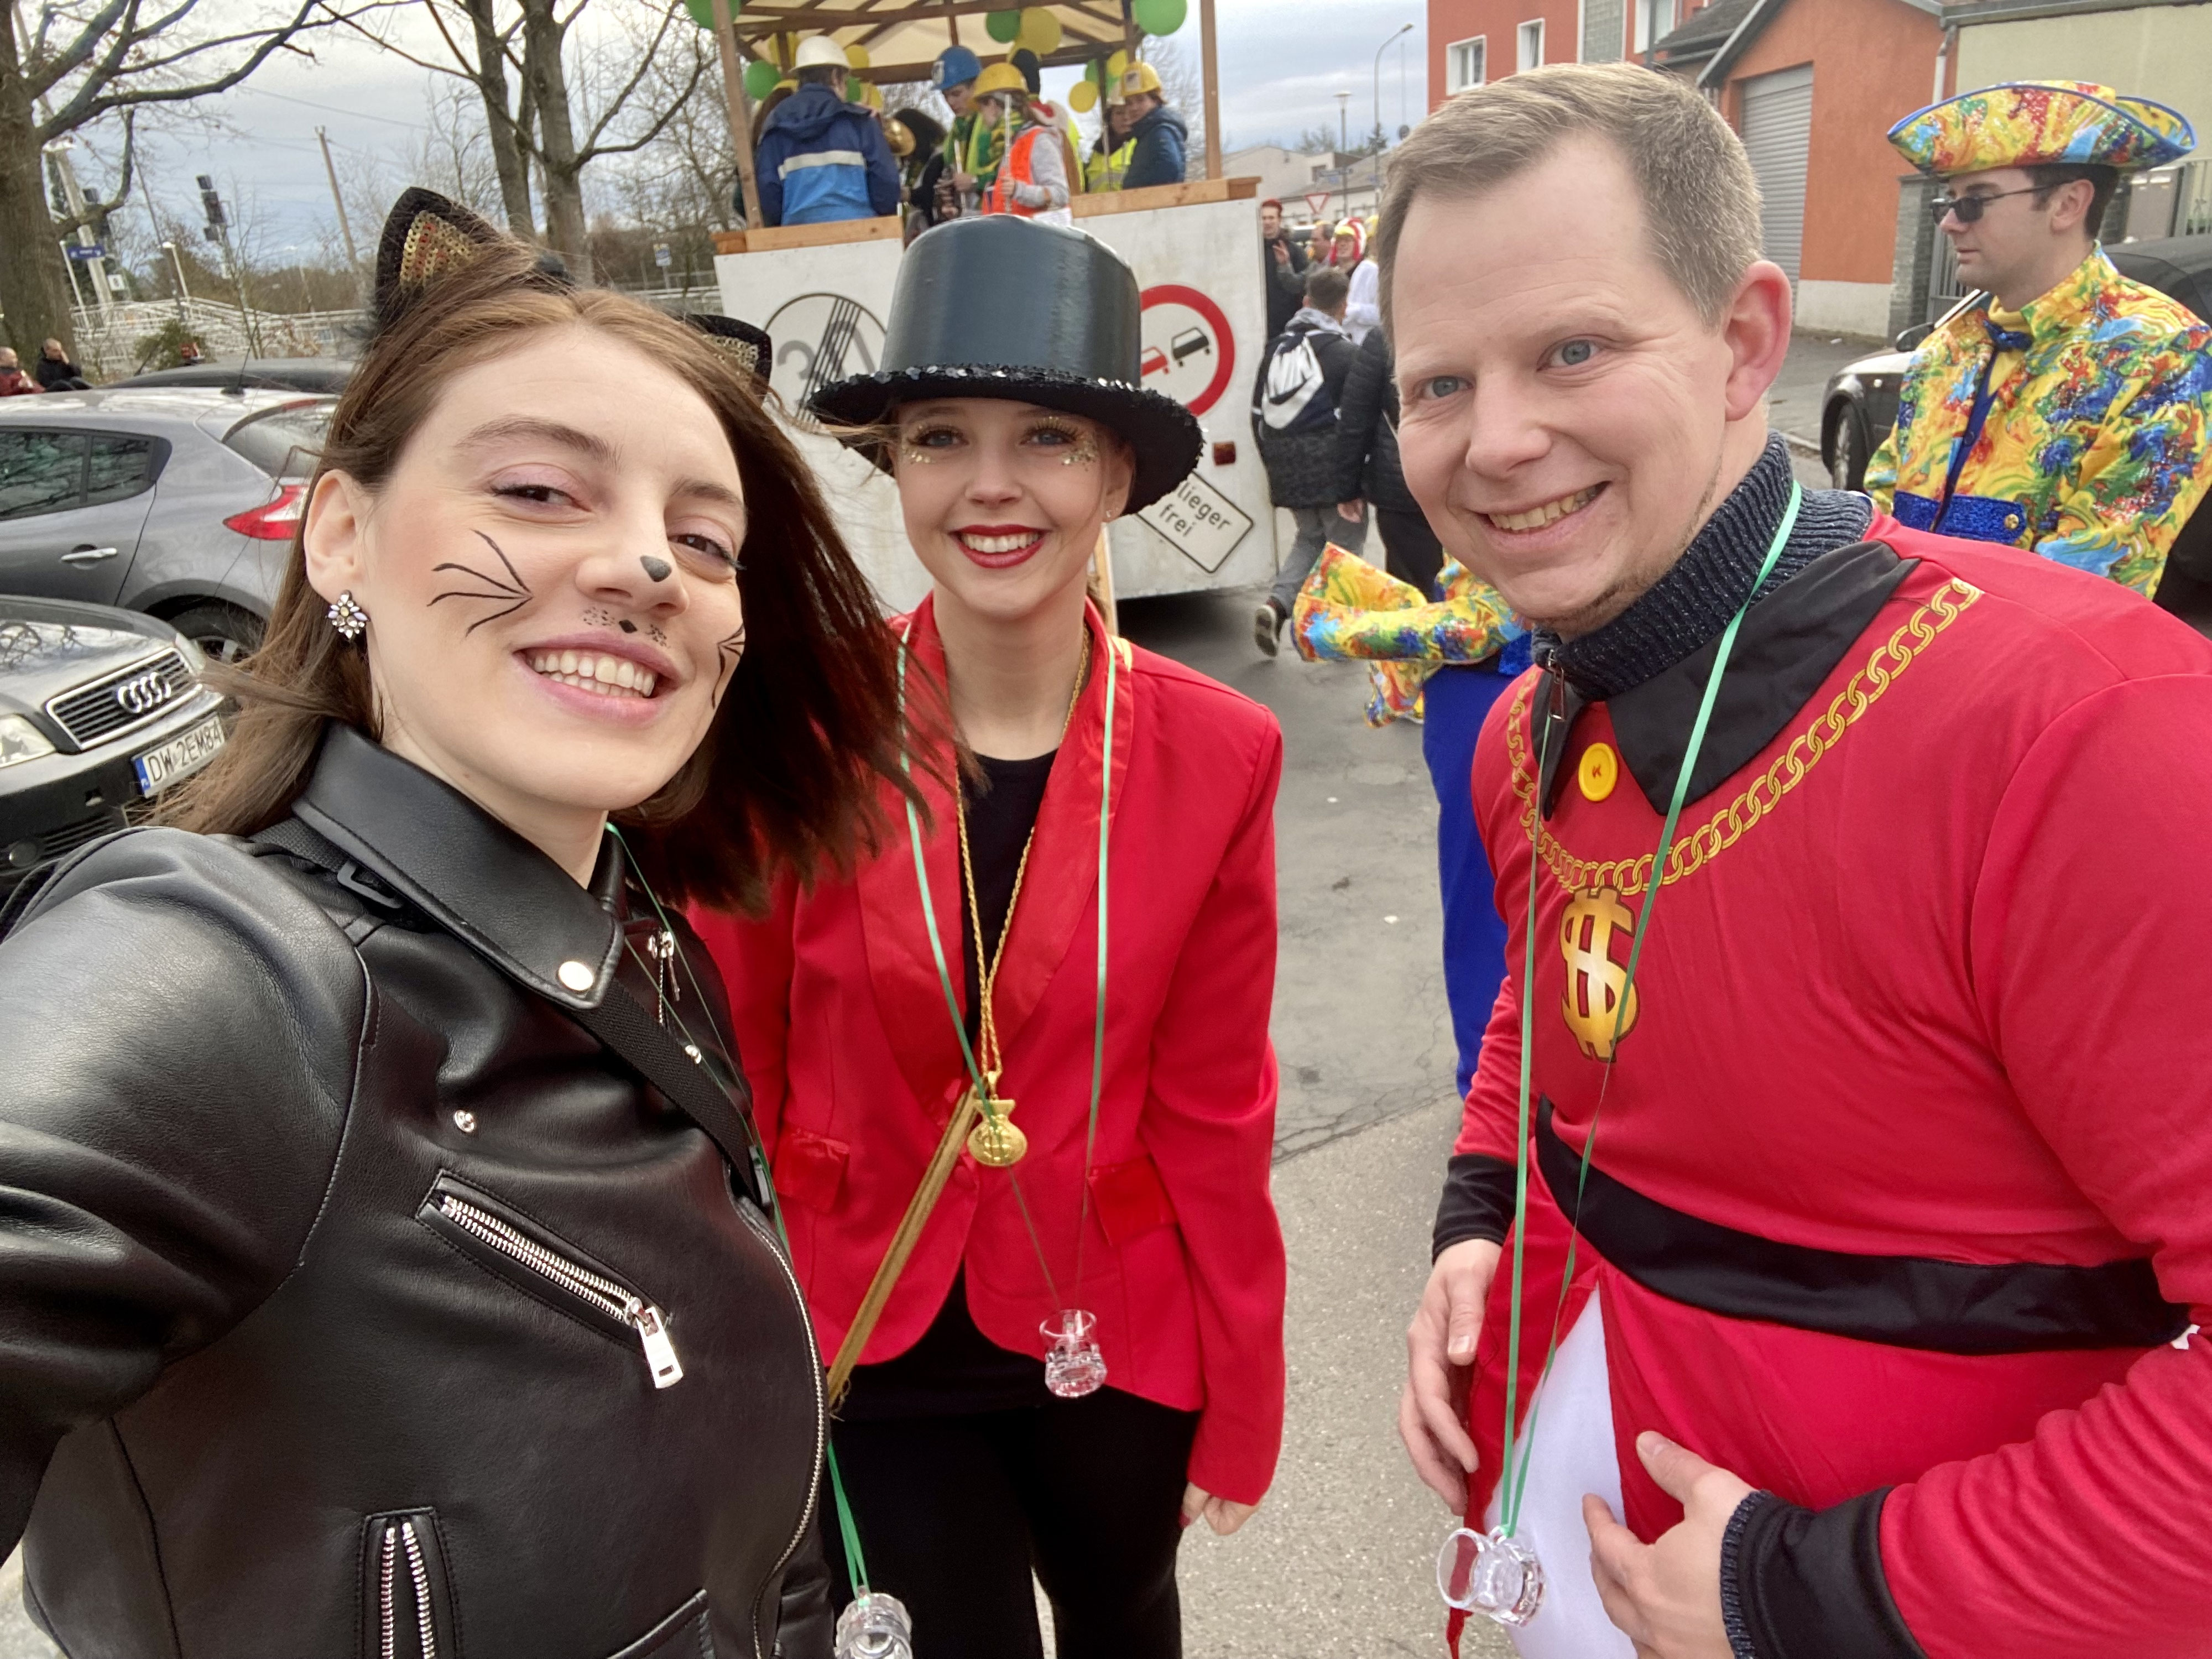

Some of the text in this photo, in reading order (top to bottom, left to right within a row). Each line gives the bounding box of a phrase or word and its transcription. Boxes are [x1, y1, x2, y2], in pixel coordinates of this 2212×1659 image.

[1159, 503, 1197, 537] frei
[1177, 481, 1232, 530] lieger
[148, 720, 222, 782] DW 2EM84
